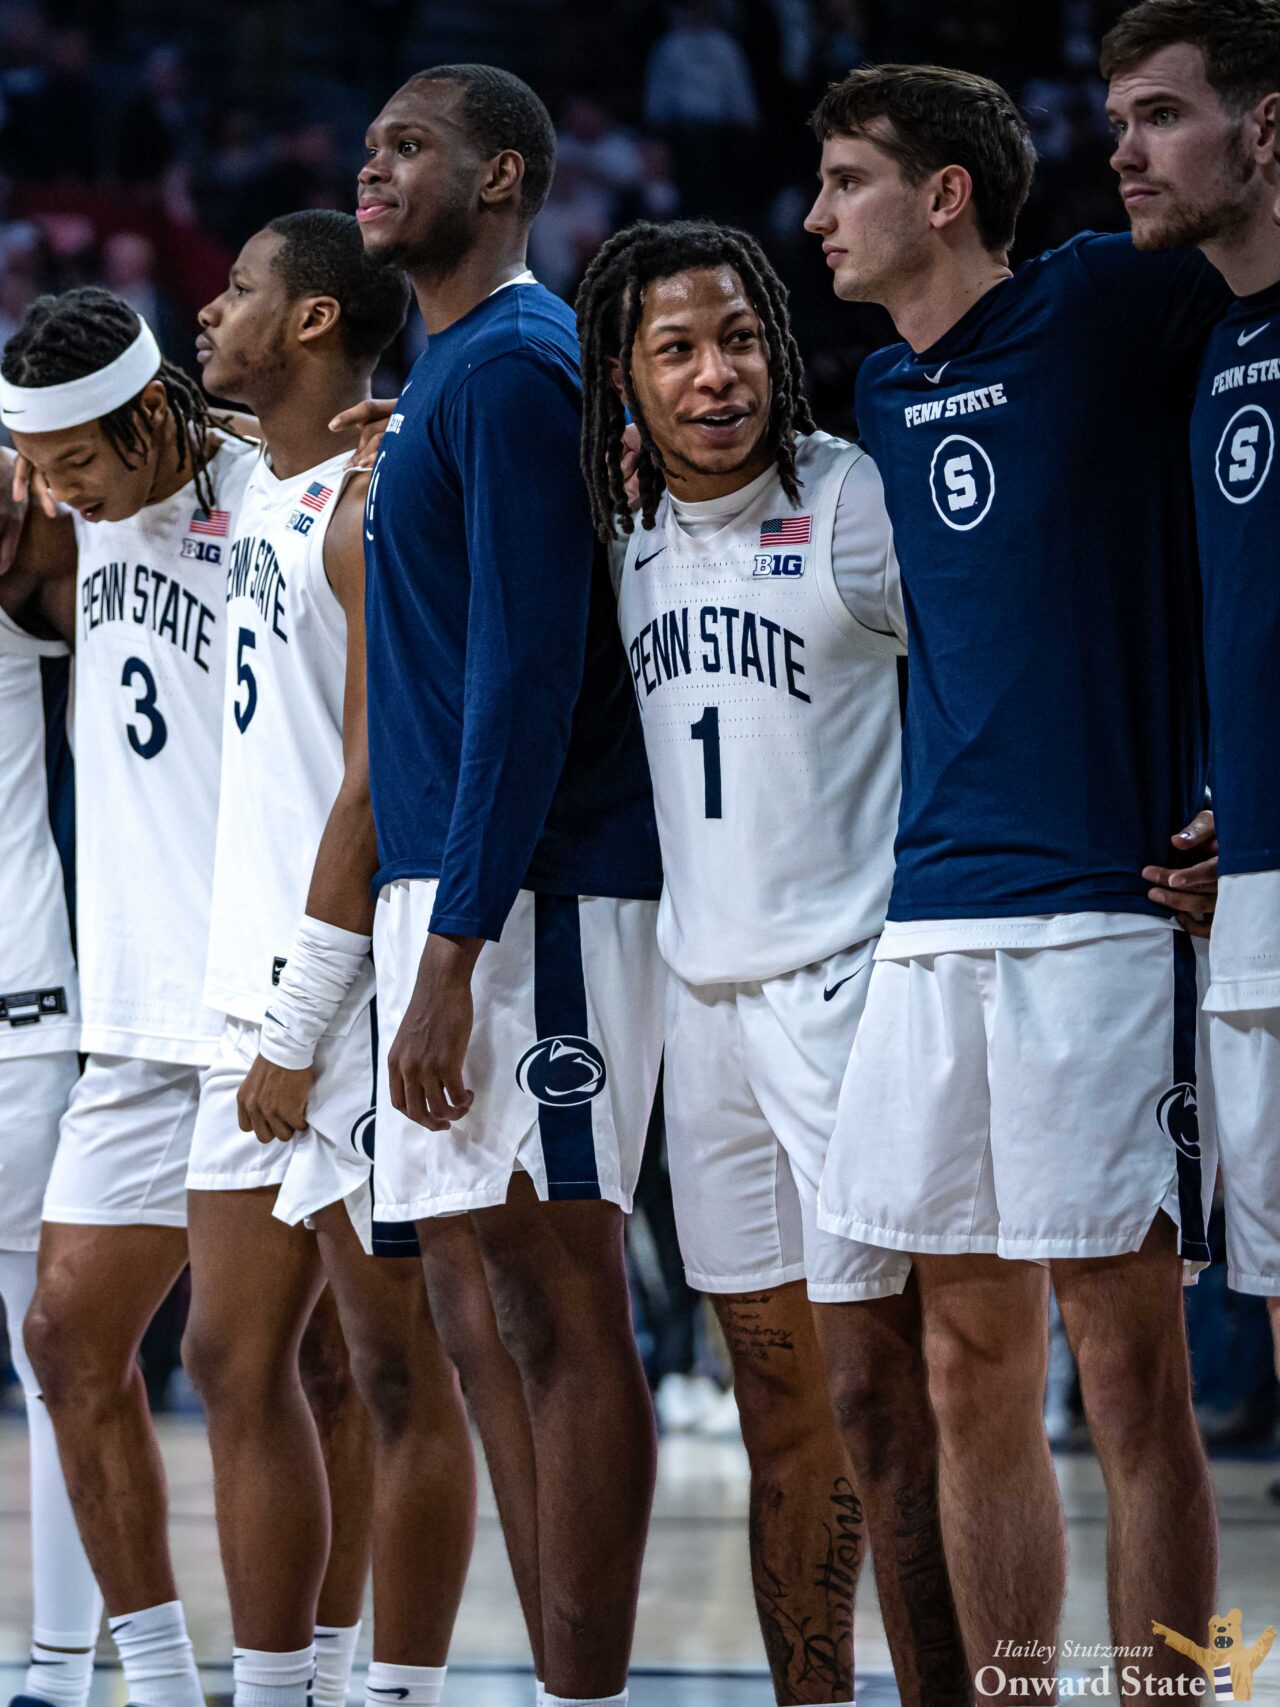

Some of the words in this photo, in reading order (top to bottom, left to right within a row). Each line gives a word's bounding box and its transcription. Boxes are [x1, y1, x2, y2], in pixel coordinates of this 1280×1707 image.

[904, 399, 946, 428] PENN
[945, 383, 1008, 418] STATE
[1212, 365, 1246, 396] PENN
[943, 453, 977, 512] S
[1229, 425, 1259, 482] S
[82, 562, 127, 641] PENN
[132, 563, 217, 675] STATE
[250, 538, 288, 645] STATE
[121, 655, 168, 760] 3
[233, 627, 258, 735] 5
[630, 607, 692, 711] PENN
[700, 605, 812, 705] STATE
[690, 706, 723, 820] 1
